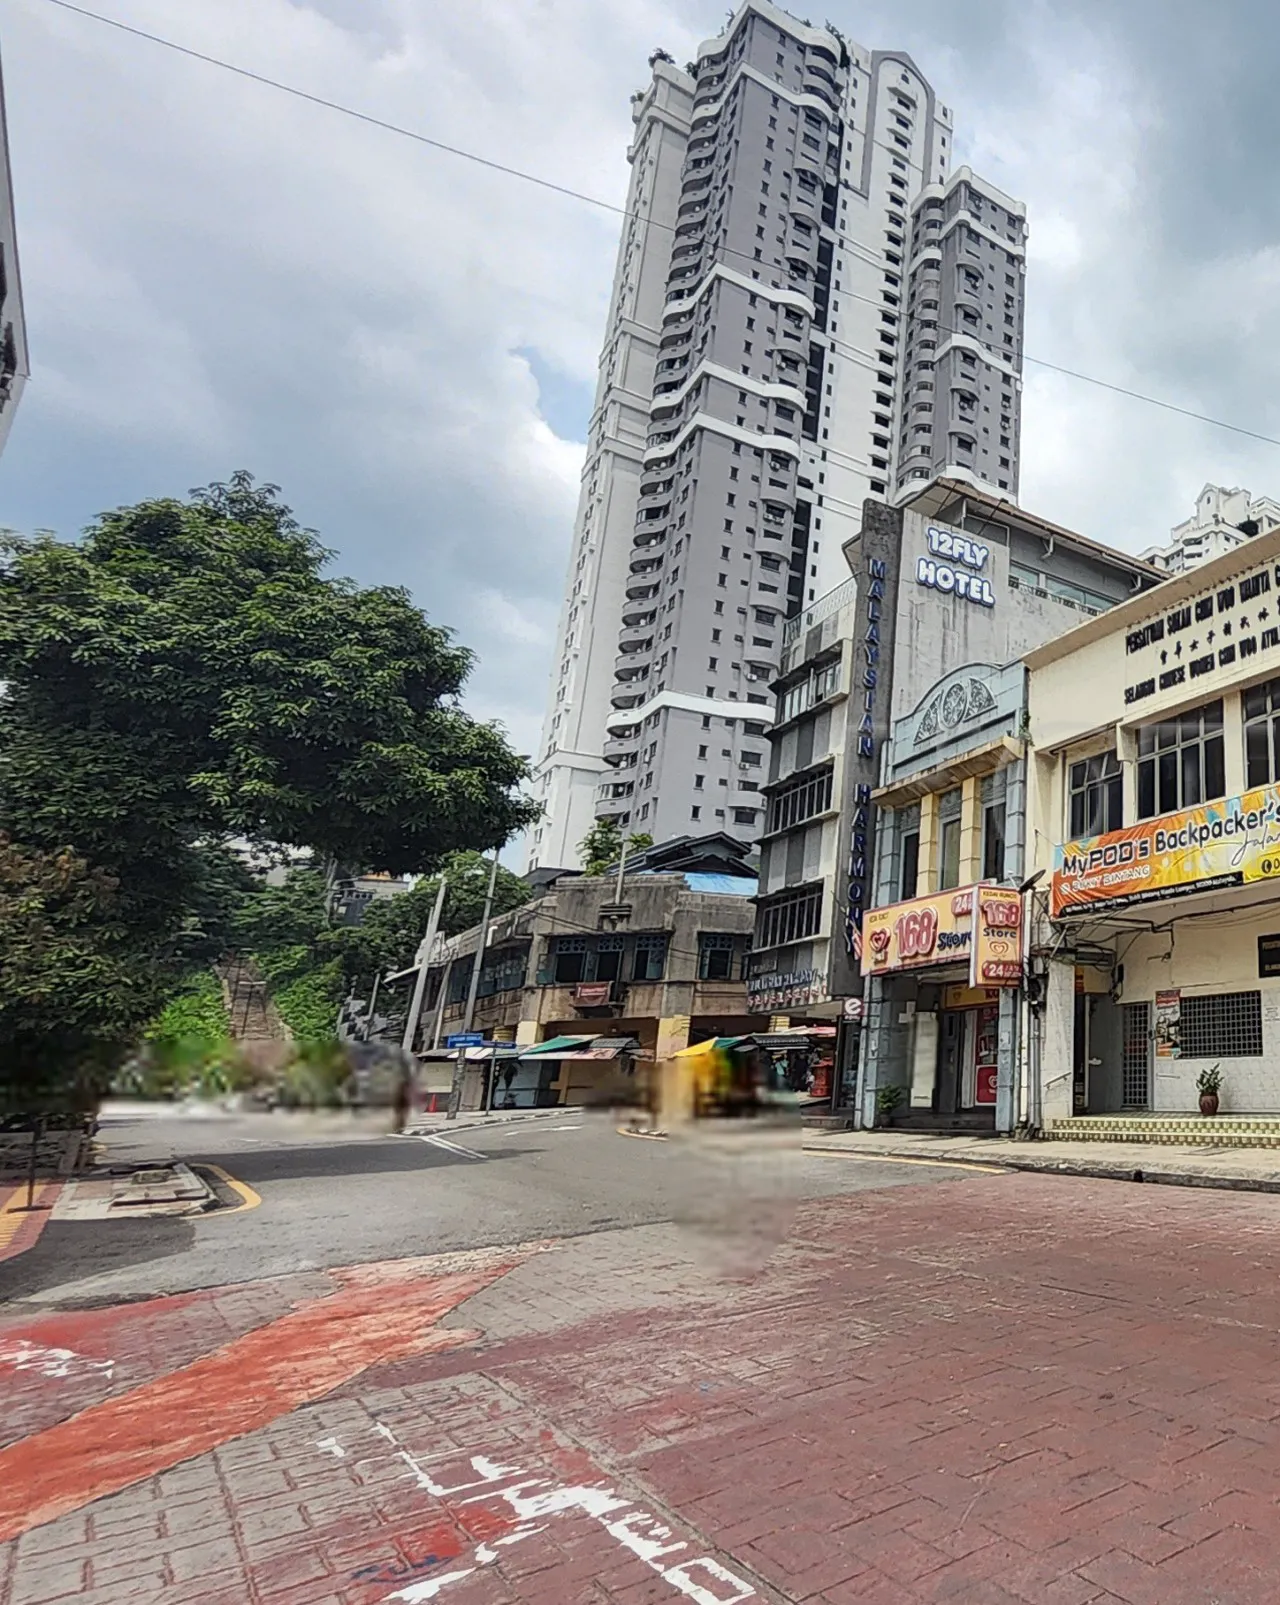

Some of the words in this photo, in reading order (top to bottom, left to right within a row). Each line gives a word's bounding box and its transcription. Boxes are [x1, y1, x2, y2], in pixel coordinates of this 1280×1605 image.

[926, 526, 989, 570] 12FLY
[915, 557, 996, 609] HOTEL
[856, 557, 888, 758] MALAYSIAN
[1062, 838, 1149, 877] MyPOD's
[894, 907, 938, 958] 168
[983, 900, 1020, 927] 168
[983, 927, 1017, 938] Store
[937, 930, 973, 951] Stor
[989, 964, 1003, 977] 24
